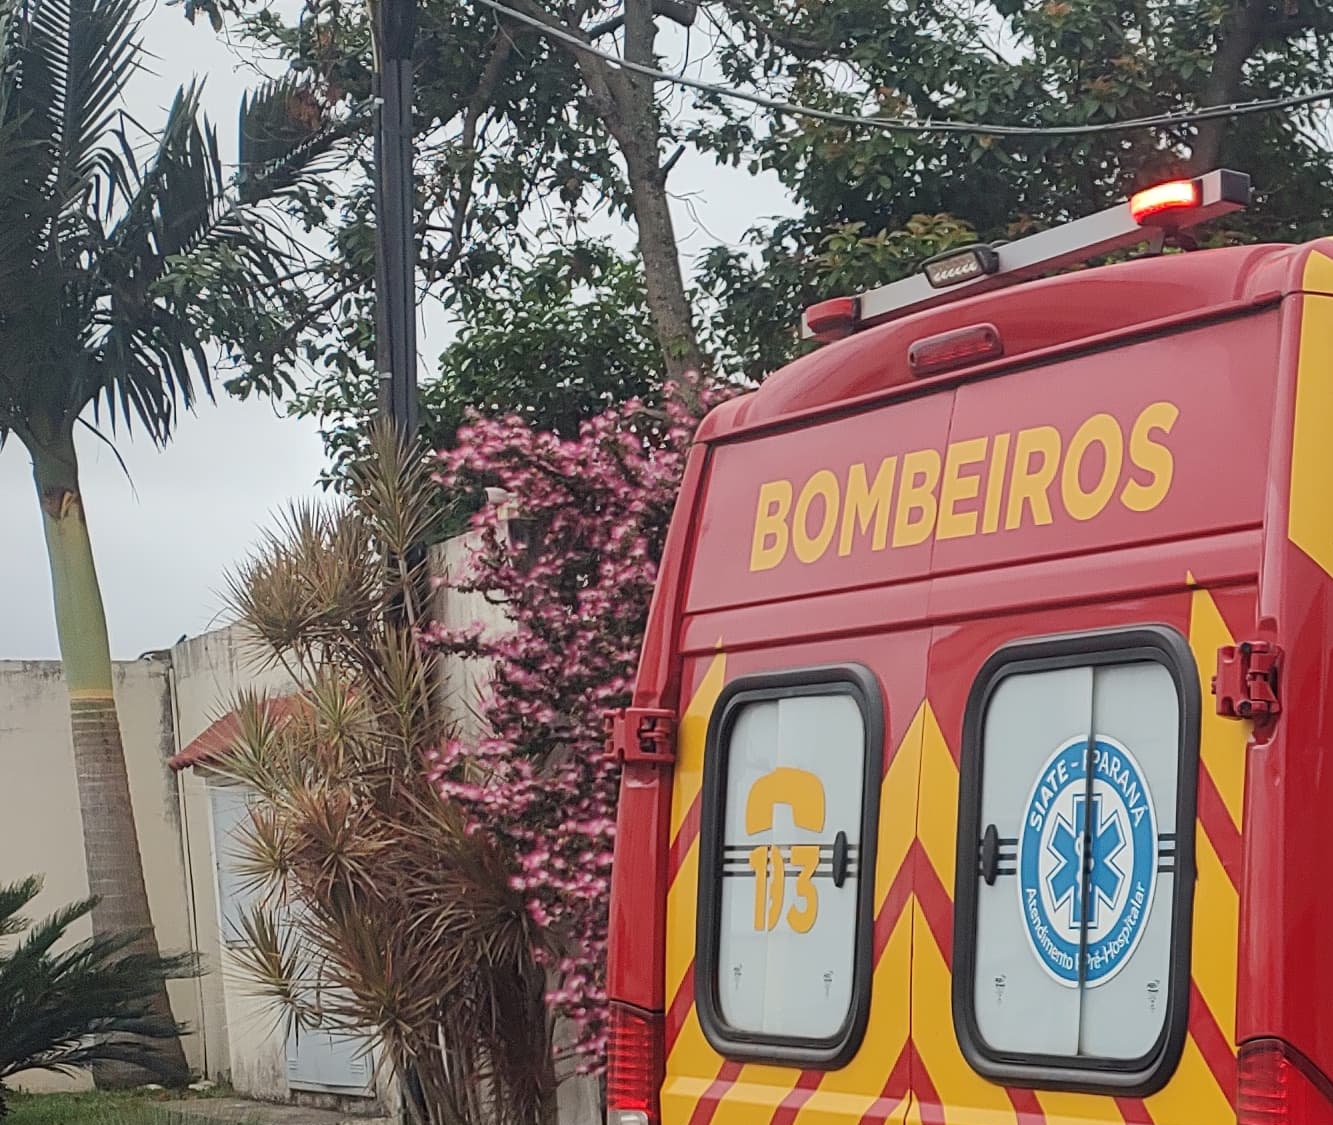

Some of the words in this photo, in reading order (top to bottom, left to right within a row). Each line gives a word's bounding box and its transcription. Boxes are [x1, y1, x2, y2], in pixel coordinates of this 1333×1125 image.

[749, 401, 1179, 572] BOMBEIROS
[1029, 758, 1070, 832] SIATE
[1082, 748, 1149, 827] PARANÁ
[1025, 888, 1074, 971] Atendimento
